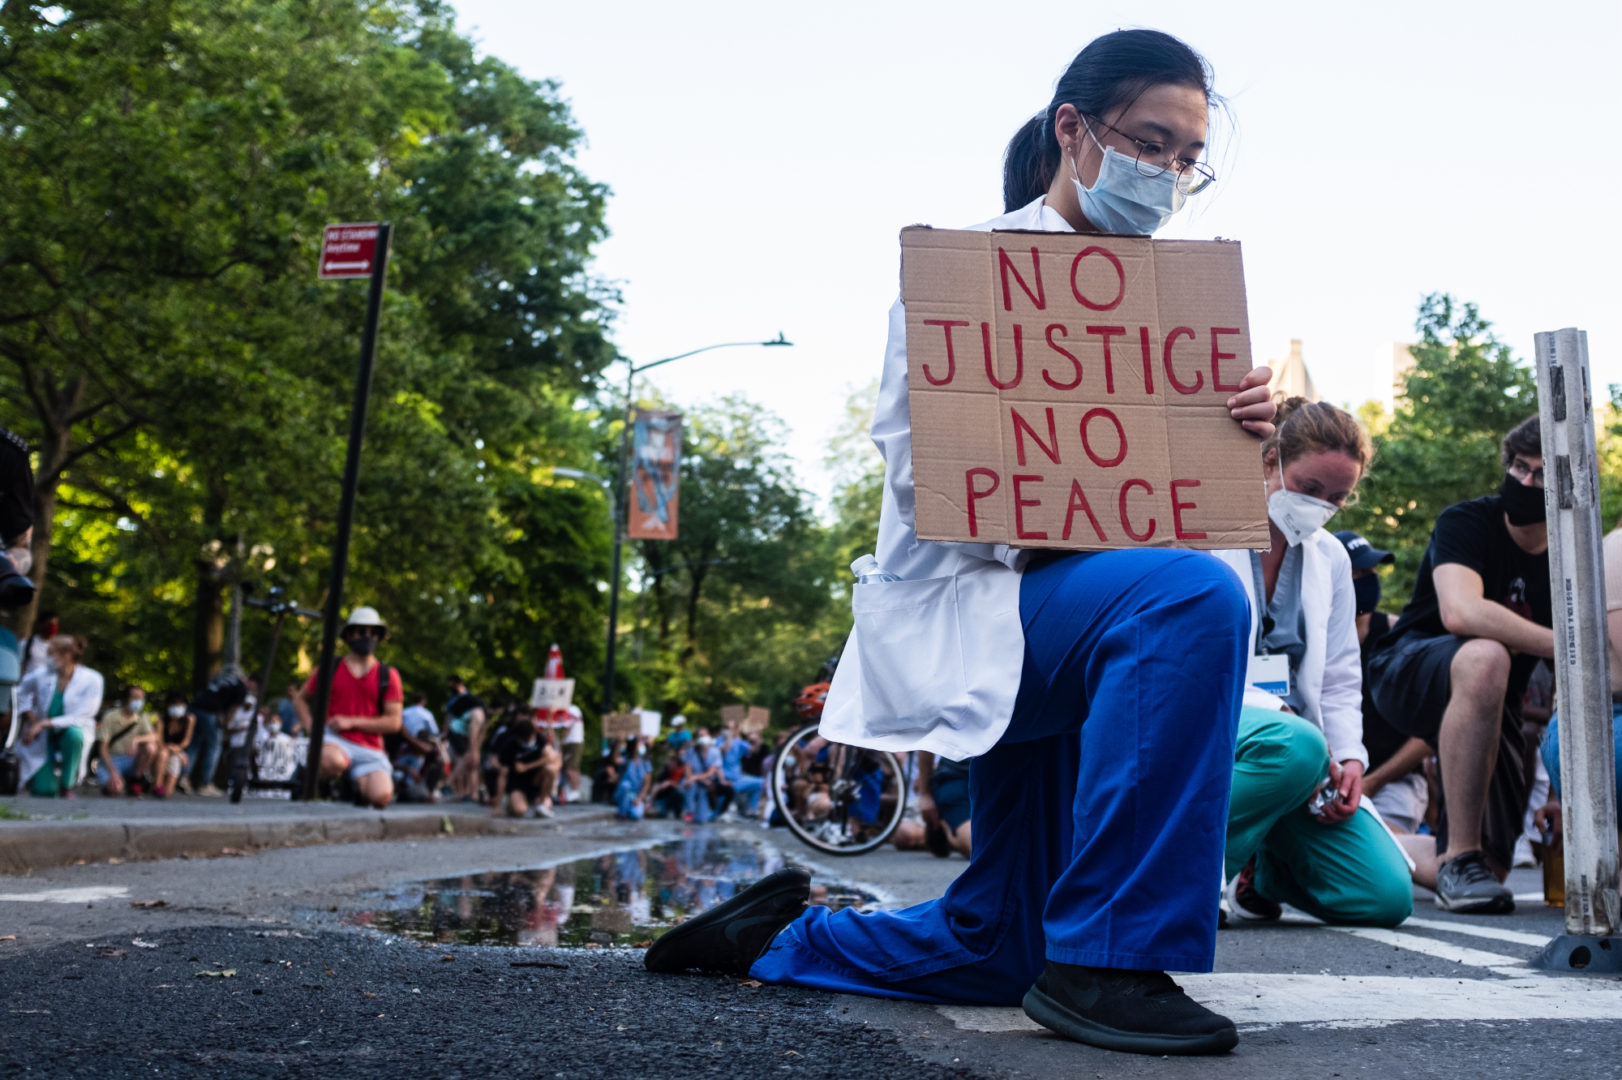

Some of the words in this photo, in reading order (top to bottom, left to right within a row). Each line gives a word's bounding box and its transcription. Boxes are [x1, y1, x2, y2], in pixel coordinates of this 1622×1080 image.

[998, 245, 1126, 312] NO
[922, 318, 1241, 395] JUSTICE
[1010, 406, 1128, 468] NO
[965, 466, 1208, 542] PEACE
